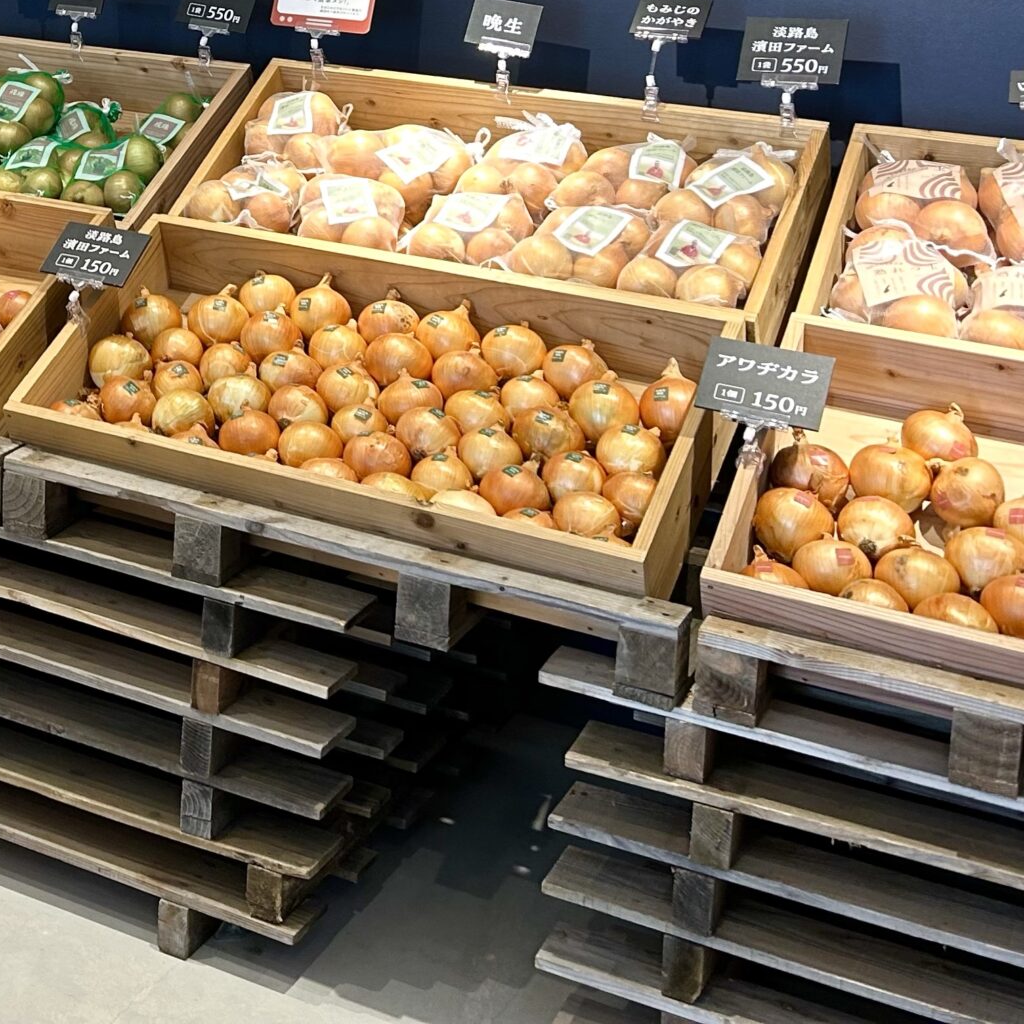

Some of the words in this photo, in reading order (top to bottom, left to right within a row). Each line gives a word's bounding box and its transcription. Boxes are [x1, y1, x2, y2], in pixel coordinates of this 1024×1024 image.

[206, 5, 240, 24] 550円
[646, 2, 700, 17] もみじの
[482, 14, 524, 36] 晩生
[641, 14, 697, 28] かがやき
[772, 25, 819, 40] 淡路島
[751, 39, 834, 55] 濱田ファーム
[780, 57, 828, 75] 550円
[84, 228, 123, 246] 淡路島
[62, 238, 130, 260] 濱田ファーム
[80, 258, 120, 277] 150円
[715, 353, 820, 385] アワヂカラ
[750, 391, 808, 417] 150円
